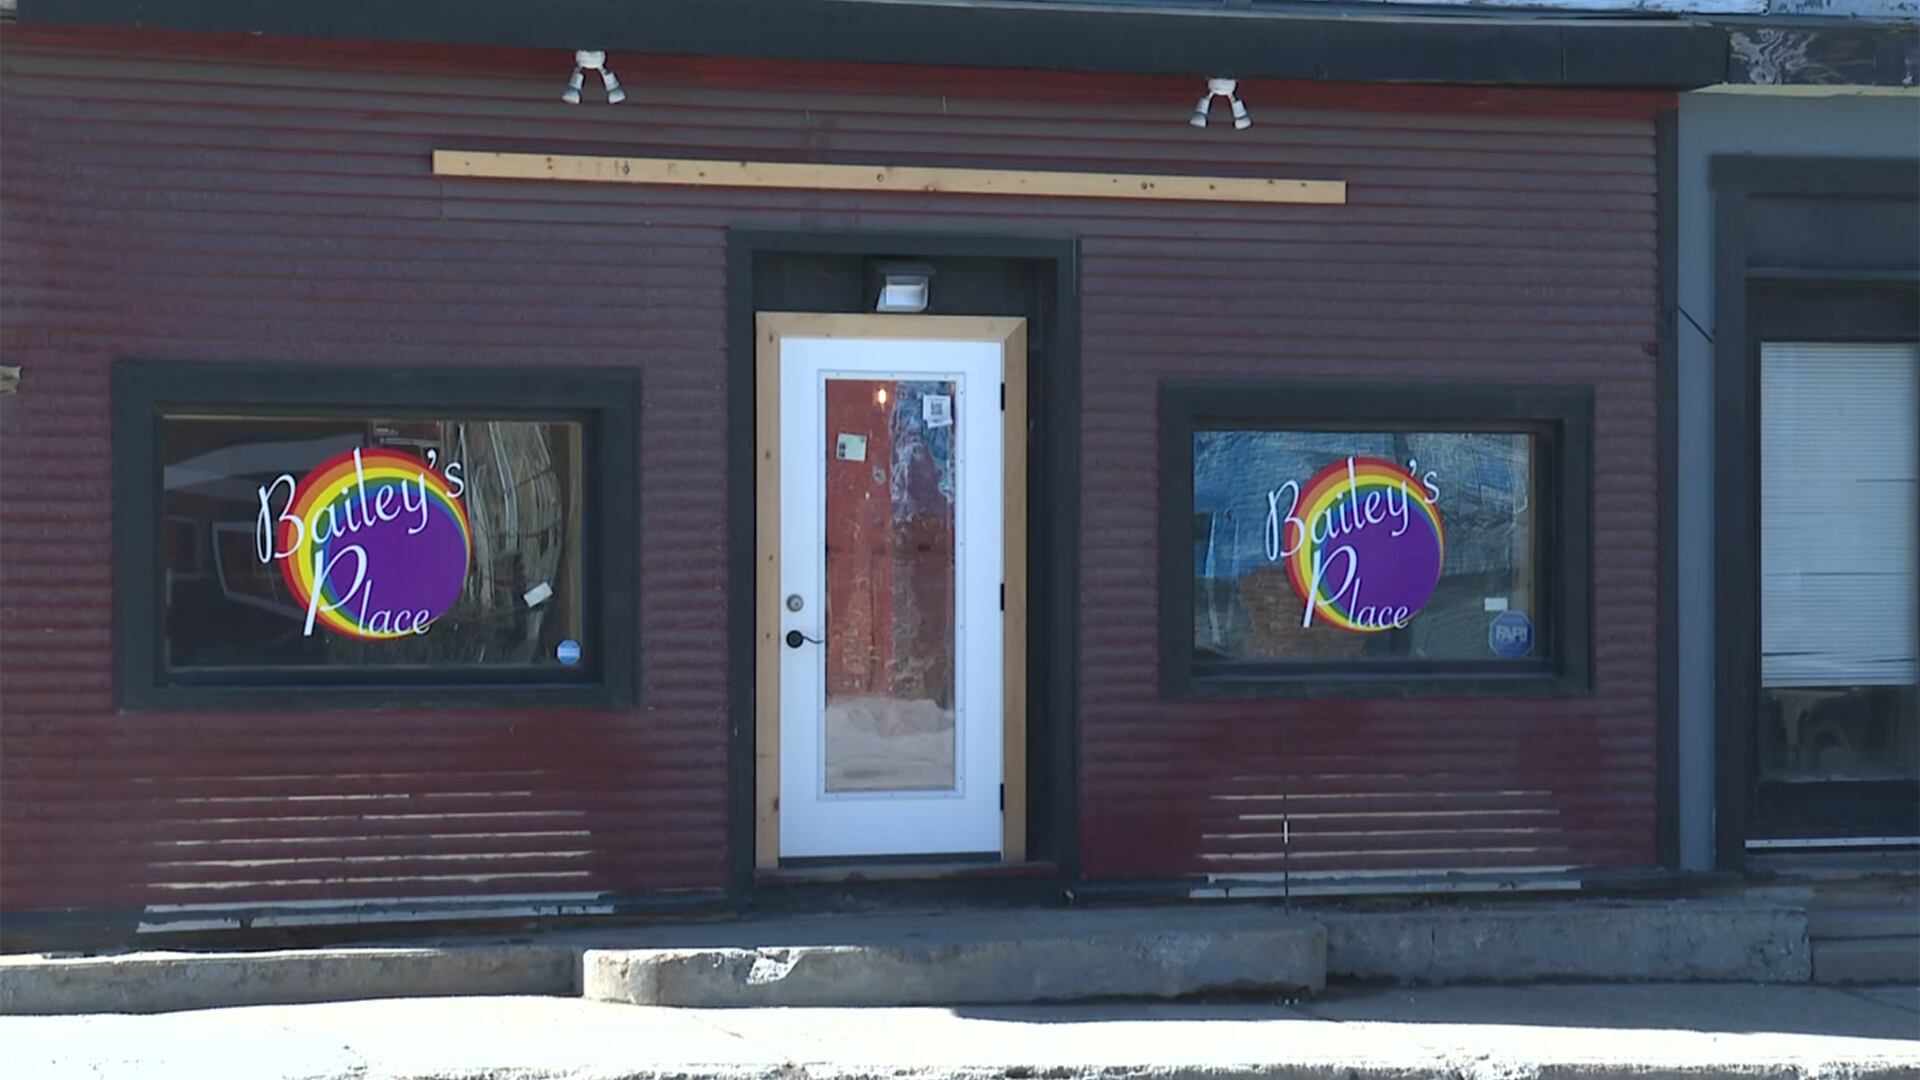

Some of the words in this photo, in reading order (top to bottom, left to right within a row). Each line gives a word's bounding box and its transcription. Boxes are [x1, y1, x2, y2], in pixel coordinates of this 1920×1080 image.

[256, 447, 464, 563] Bailey's
[1266, 456, 1439, 561] Bailey's
[304, 545, 430, 636] Place
[1303, 545, 1409, 628] Place
